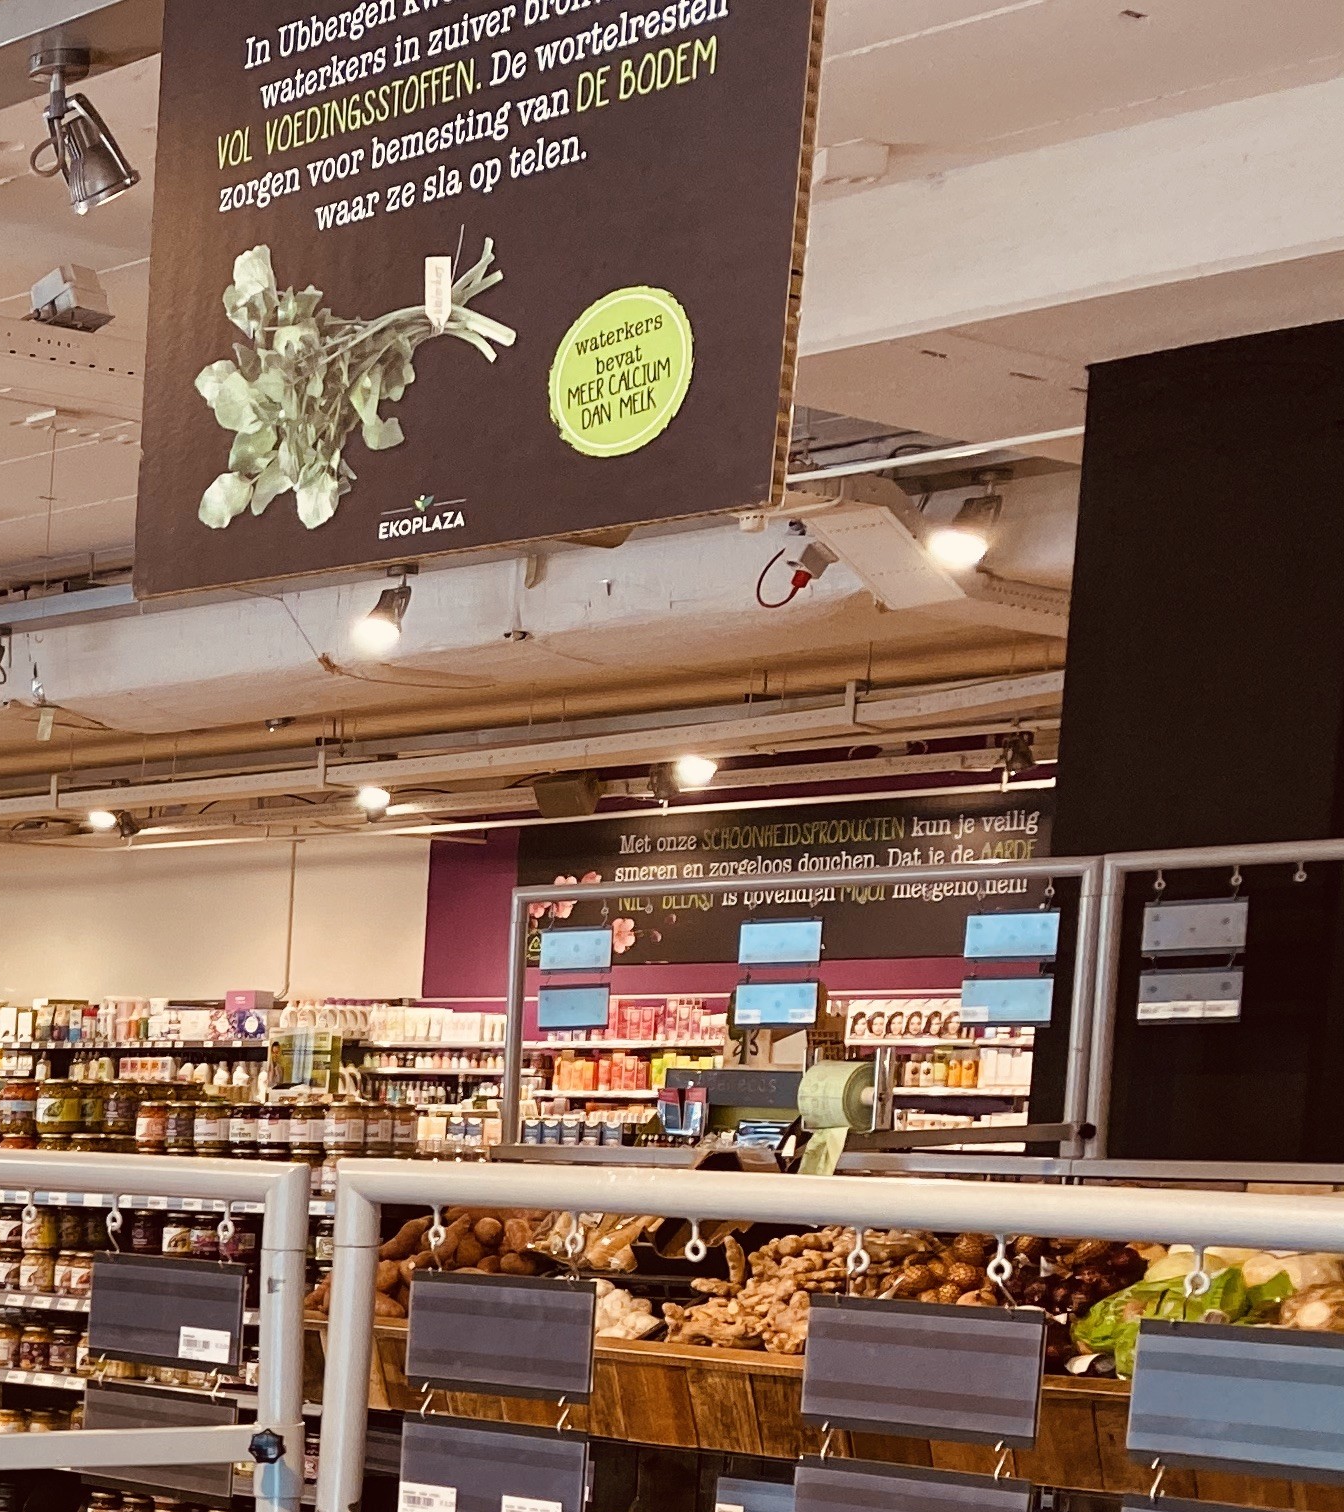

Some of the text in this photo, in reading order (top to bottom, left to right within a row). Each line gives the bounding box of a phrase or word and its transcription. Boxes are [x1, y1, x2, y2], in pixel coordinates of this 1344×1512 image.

[244, 35, 271, 70] In
[278, 0, 396, 58] Ubbergen
[260, 45, 386, 109] waterkers
[394, 35, 420, 68] in
[427, 6, 516, 56] zuiver
[217, 0, 729, 170] VOL VOEDINGSSTOFFEN. De wortelresten
[219, 35, 718, 212] zorgen voor bemesting van DE BODEM
[315, 135, 587, 231] waar ze sla op telen.
[574, 315, 664, 356] waterkers
[596, 346, 643, 374] bevat
[567, 356, 671, 410] MEER CALCIUM
[581, 386, 656, 431] DAN MELK
[377, 512, 466, 539] EKOPLAZA
[619, 810, 1040, 854] Met onze SCHOONHEIDSPRODUCTEN kun je veilig
[615, 865, 677, 882] smeren
[683, 862, 703, 878] en
[709, 856, 792, 877] zorgeloos
[798, 850, 880, 872] douchen.
[888, 847, 922, 867] Dat
[950, 845, 974, 864] de
